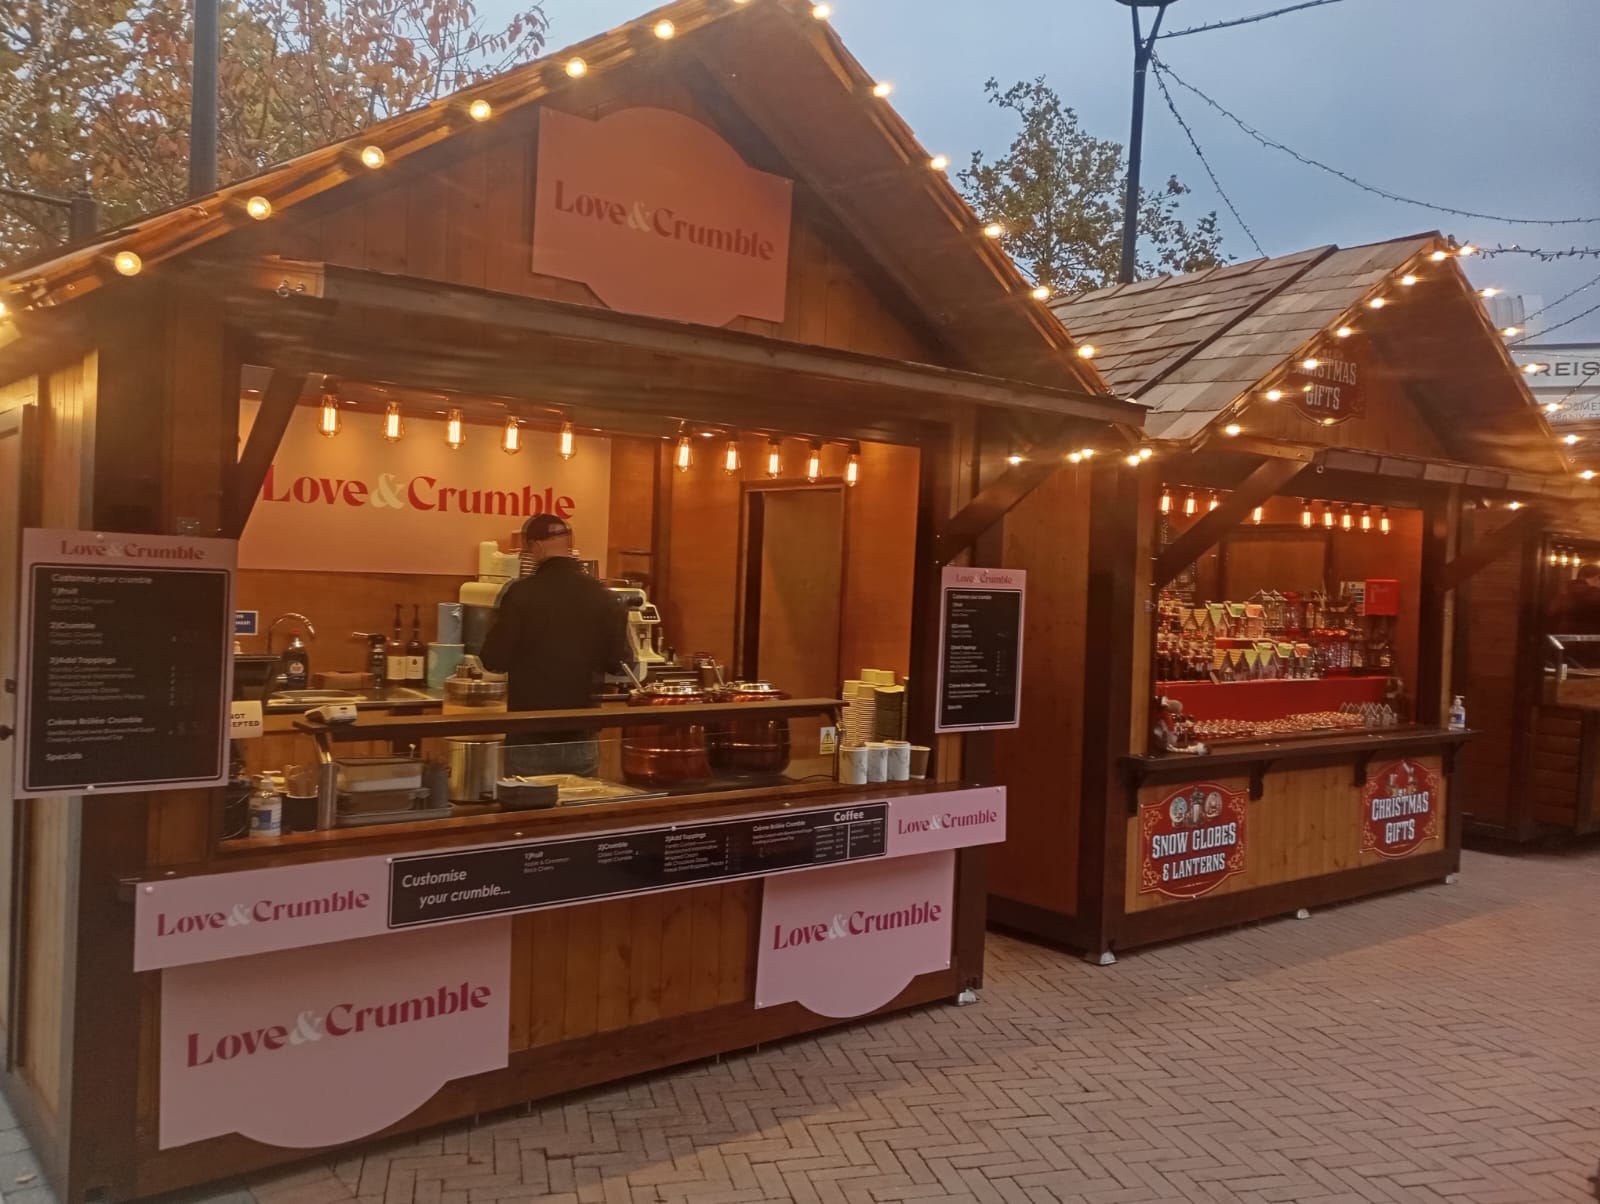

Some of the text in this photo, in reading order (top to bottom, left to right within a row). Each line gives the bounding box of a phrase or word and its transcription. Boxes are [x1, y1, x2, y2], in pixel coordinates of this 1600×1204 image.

[555, 179, 775, 261] Love&Crumble
[1305, 381, 1341, 410] GIFTS
[261, 463, 576, 520] Love&Crumble
[60, 540, 205, 560] Love&Crumble
[833, 810, 865, 822] Coffee
[1372, 791, 1429, 821] CHRISTMAS
[898, 809, 998, 835] Love&Crumble
[1385, 818, 1415, 844] GIFTS
[1152, 822, 1237, 859] SNOW GLOBES
[402, 868, 467, 888] Customise
[1162, 852, 1226, 881] & LANTERNS
[157, 889, 371, 937] Love&Crumble
[419, 893, 448, 910] your
[773, 901, 942, 951] Love&Crumble
[187, 982, 491, 1067] Love&Crumble
